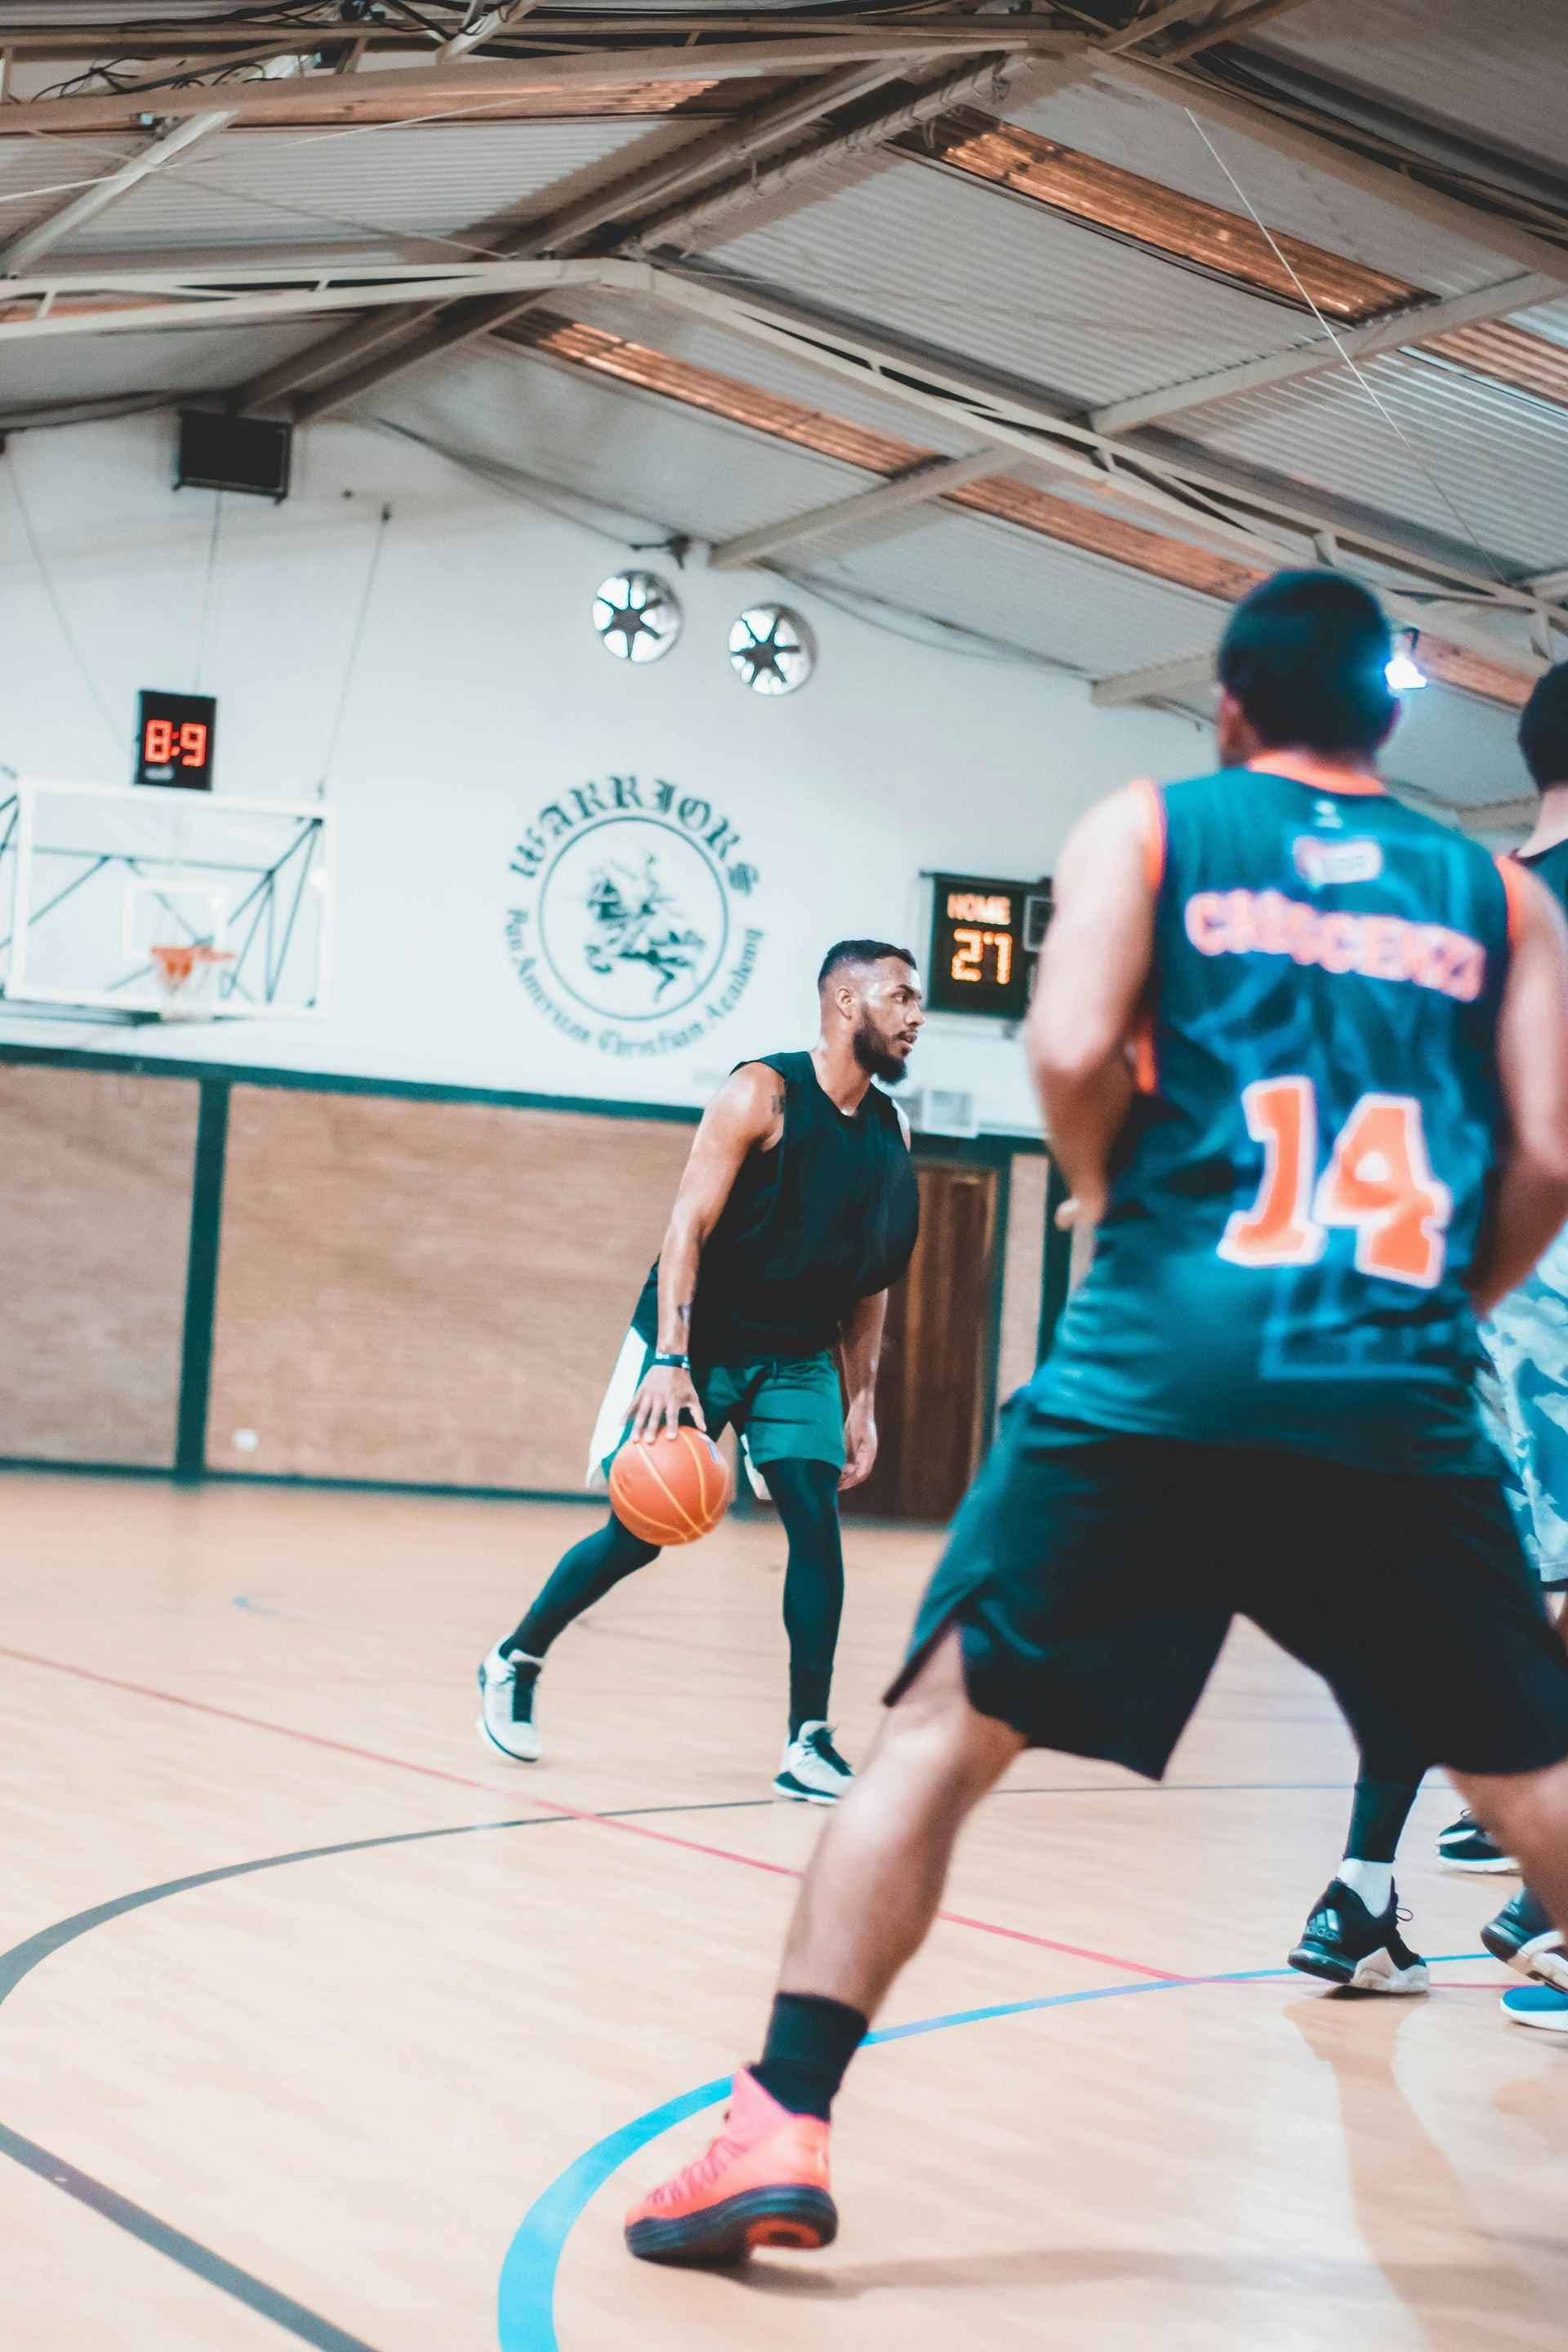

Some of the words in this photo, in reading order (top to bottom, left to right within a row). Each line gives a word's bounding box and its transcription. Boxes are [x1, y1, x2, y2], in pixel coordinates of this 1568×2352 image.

[510, 774, 761, 897] WARRIORS
[951, 928, 1013, 985] 27
[1216, 1074, 1453, 1289] 14
